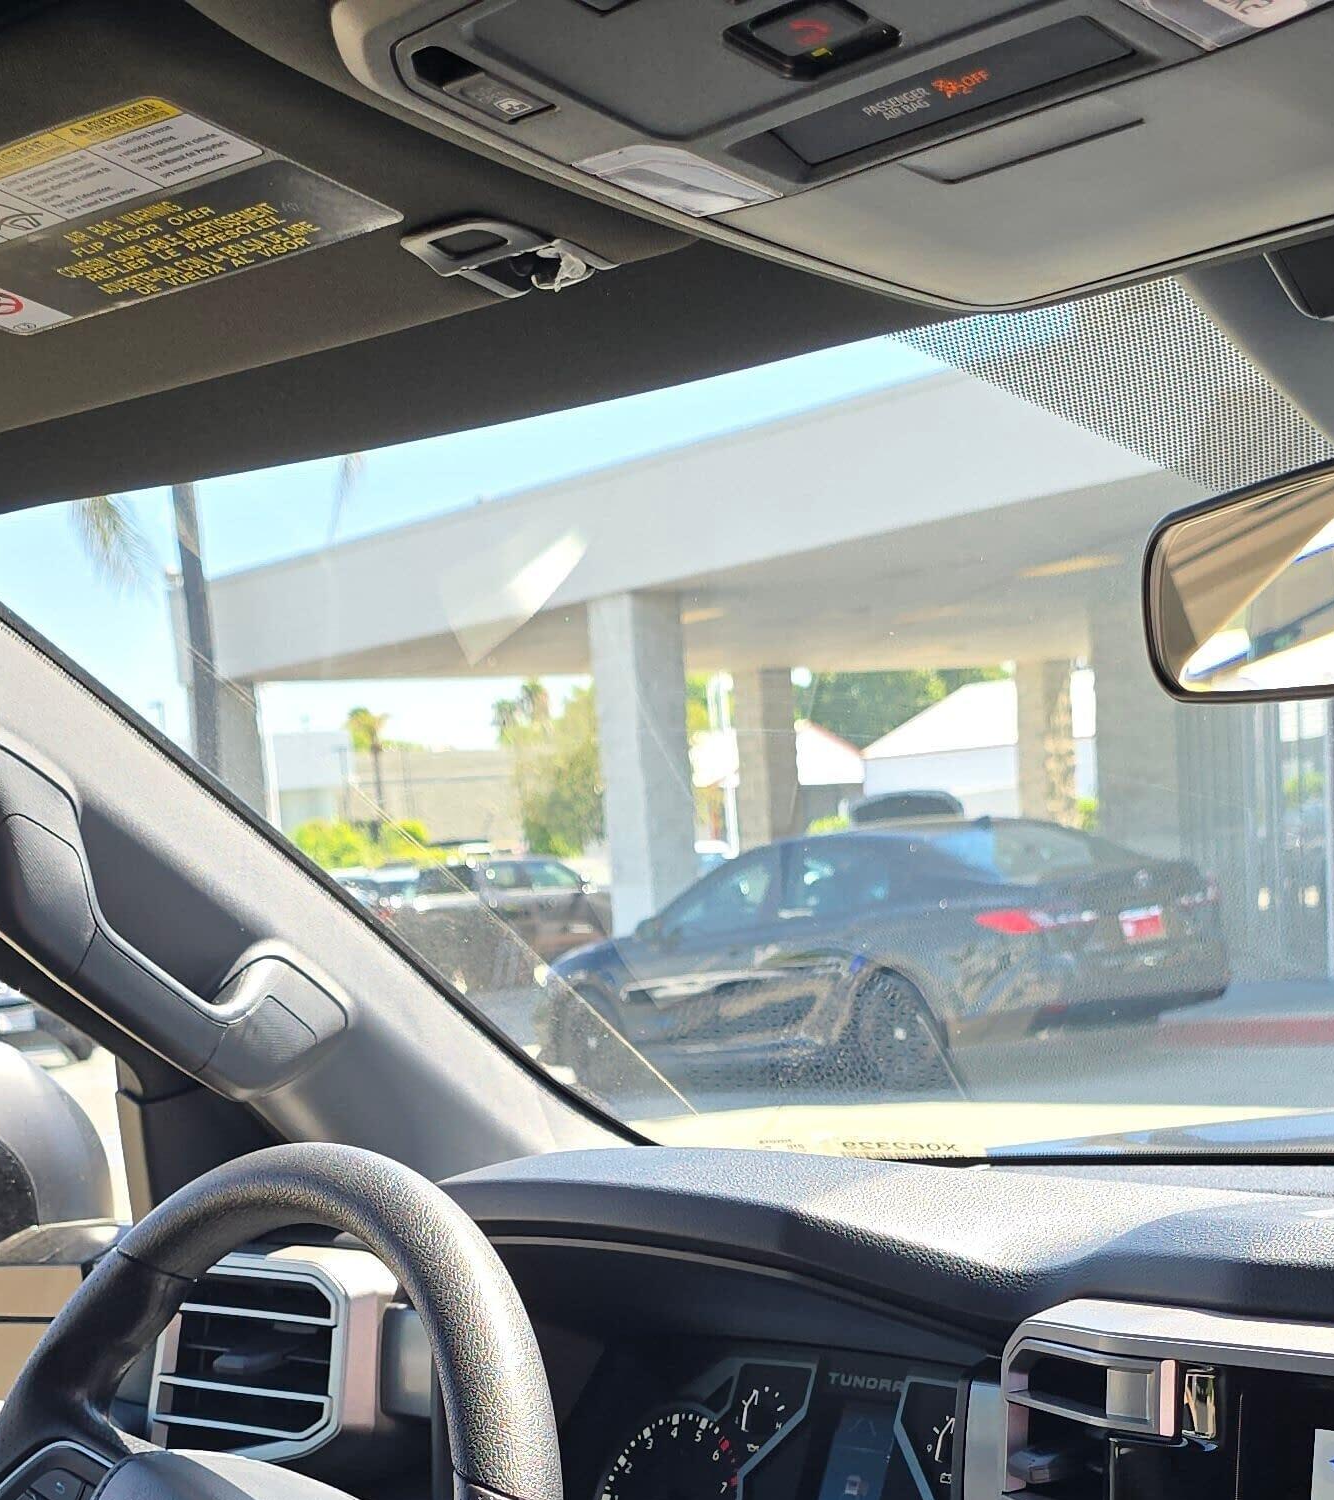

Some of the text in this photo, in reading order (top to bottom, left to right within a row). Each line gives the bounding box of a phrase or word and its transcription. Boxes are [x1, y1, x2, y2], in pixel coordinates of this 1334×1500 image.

[963, 69, 990, 87] OFF
[862, 87, 931, 117] PASSENGER
[882, 99, 931, 121] AIR BAG
[63, 201, 184, 245] AIR BAG WARNING
[70, 206, 217, 258] FLIP VISOR OVER
[56, 256, 115, 279] COUSSIN
[176, 202, 280, 242] AVERTISSEMENT
[86, 215, 287, 282] REPLIER LE PARESOLEIL
[97, 220, 322, 295] ADVERTENCIA CON LA BOLSA DE AIRE
[134, 236, 312, 297] DE VUELTA AL VISOR
[828, 1372, 904, 1392] TUNDRA
[670, 1426, 678, 1439] 4
[694, 1429, 702, 1443] 5
[645, 1437, 653, 1450] 3
[712, 1449, 720, 1461] 6
[624, 1462, 633, 1474] 2
[719, 1481, 728, 1494] 7
